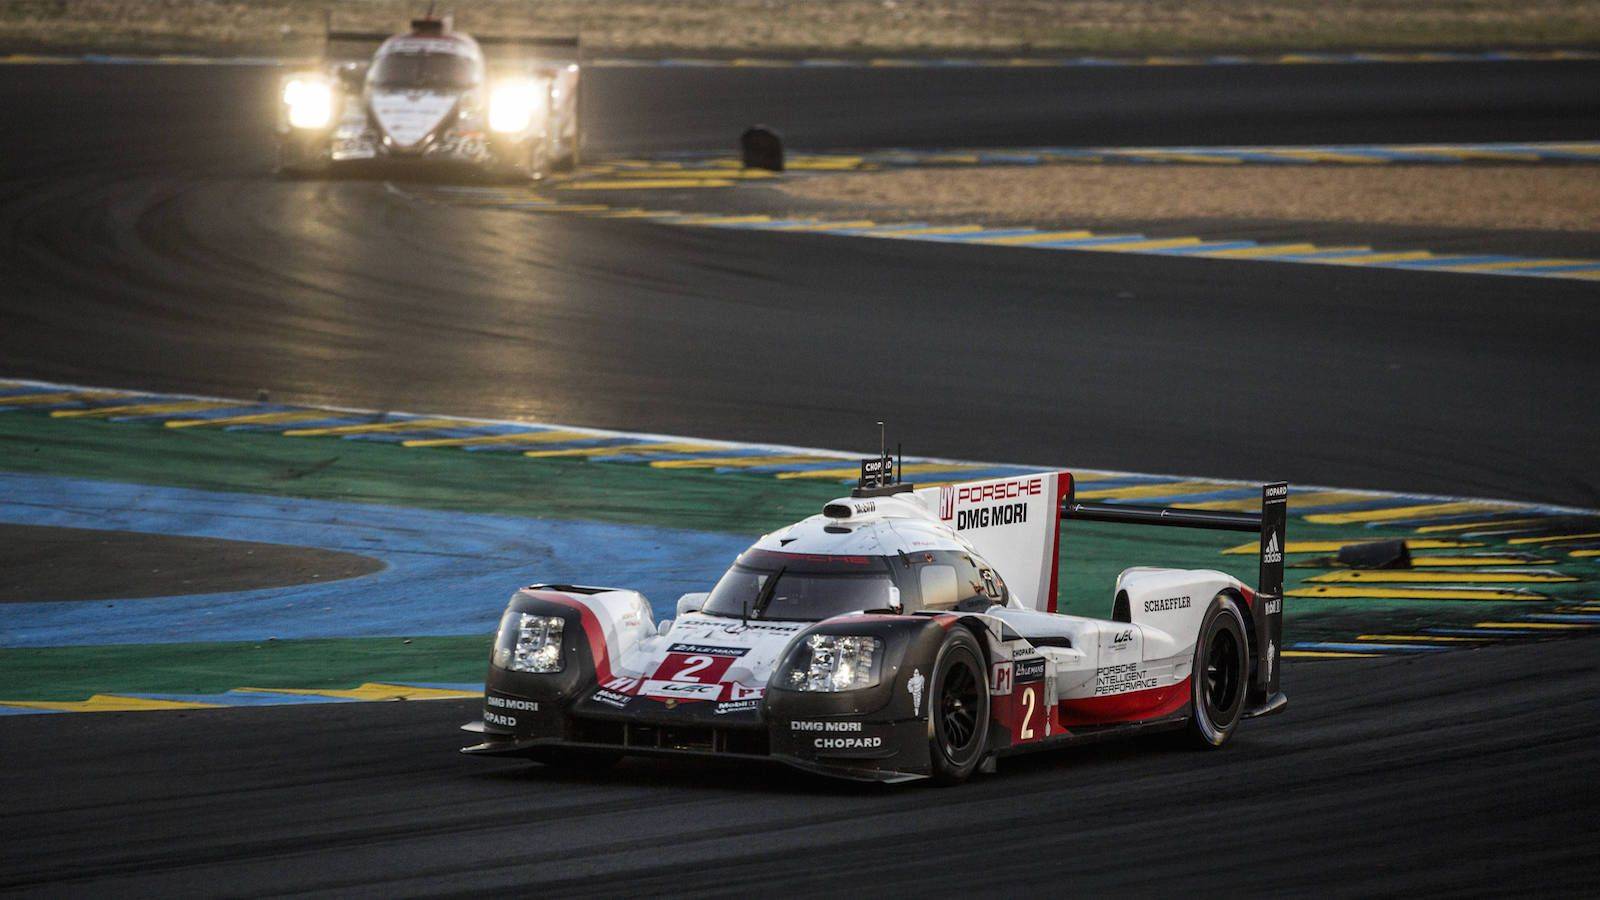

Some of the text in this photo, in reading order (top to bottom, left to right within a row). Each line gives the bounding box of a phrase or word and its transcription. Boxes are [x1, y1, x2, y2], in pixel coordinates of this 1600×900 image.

[865, 461, 891, 472] CHOPD
[959, 479, 1041, 503] PORSCHE
[958, 502, 1027, 530] DMG MORI
[1264, 553, 1281, 563] adidas
[1144, 596, 1191, 612] SCHAEFFLER
[1114, 629, 1134, 643] WEC
[1013, 648, 1035, 657] CHOPARD
[671, 655, 714, 682] 2
[1096, 662, 1137, 677] PORSCHE
[996, 668, 1011, 691] P1
[1096, 670, 1147, 686] INTELLIGENT
[661, 683, 714, 693] WEC
[1095, 678, 1158, 695] PERFORMANCE
[506, 700, 539, 711] MORI
[718, 701, 748, 709] Mobil
[483, 711, 517, 726] OPARD
[1021, 687, 1035, 740] 2
[791, 721, 862, 731] DMG MORI
[814, 737, 881, 748] CHOPARD
